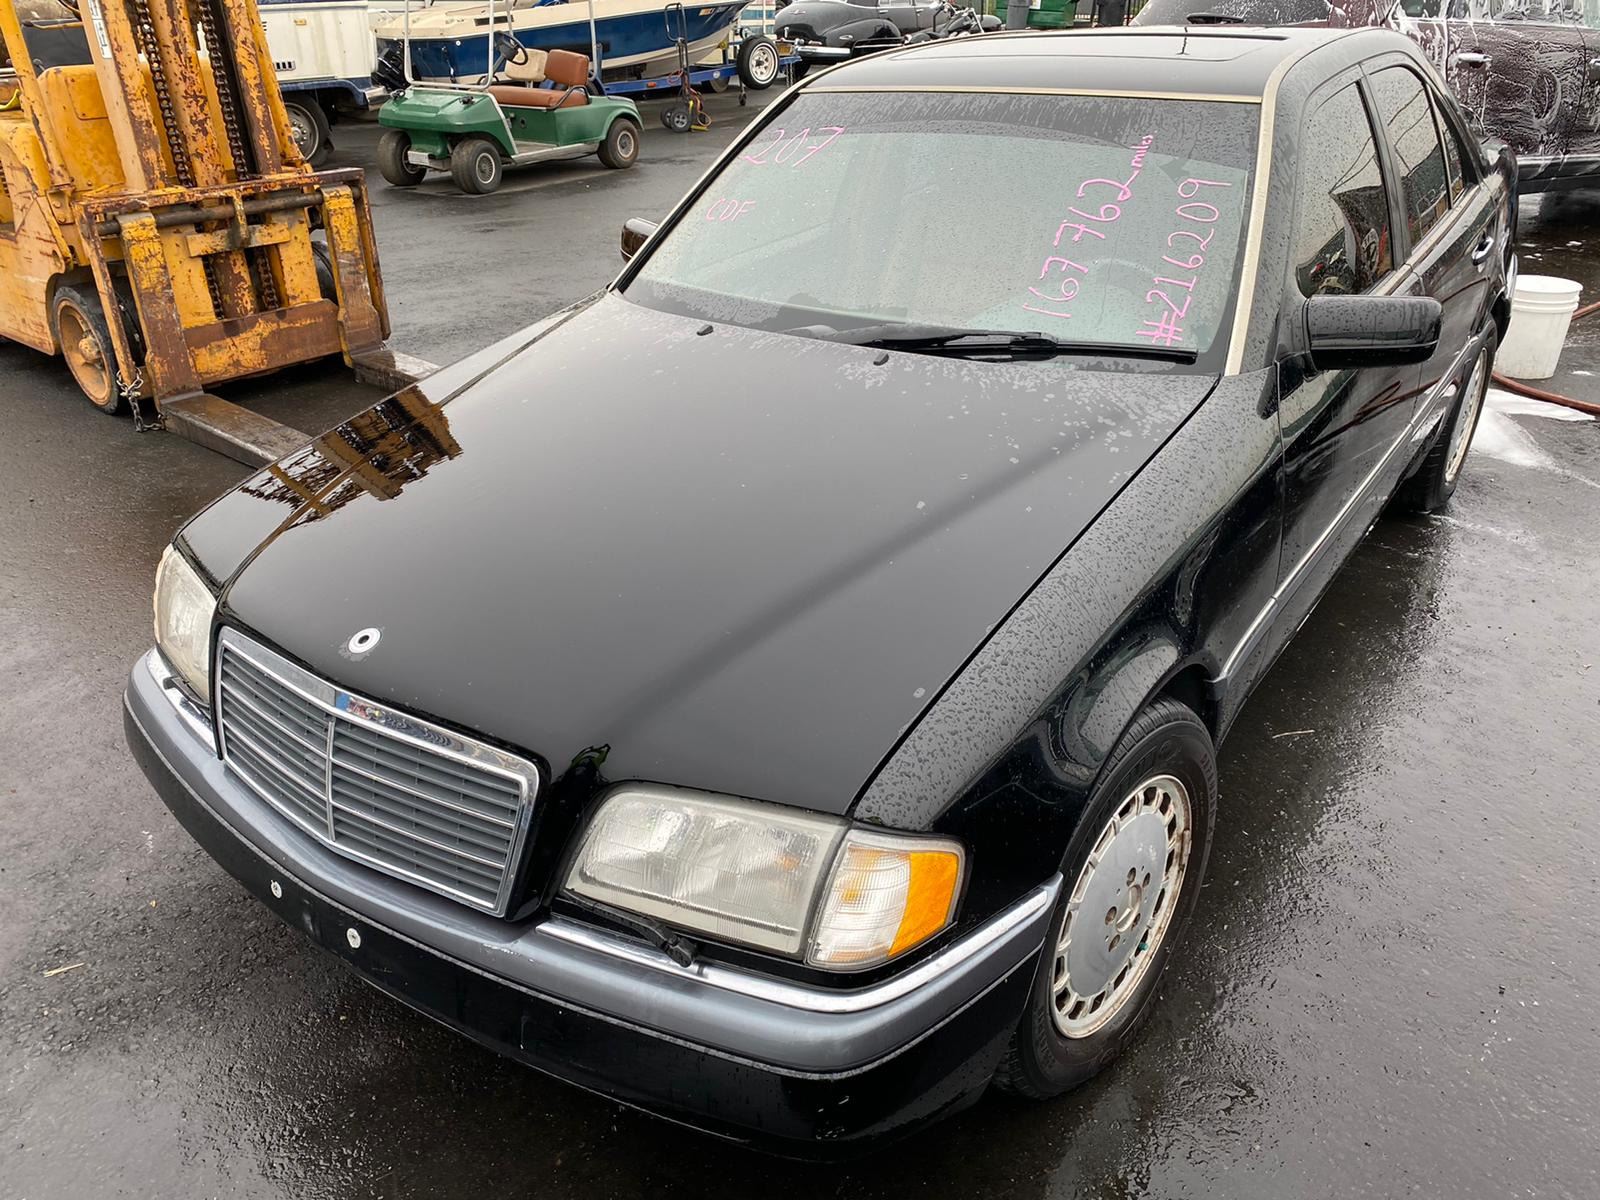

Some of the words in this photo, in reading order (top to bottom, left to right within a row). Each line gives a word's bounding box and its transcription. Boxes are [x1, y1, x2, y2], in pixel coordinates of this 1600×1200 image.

[744, 126, 846, 167] 207
[705, 198, 755, 222] CDF
[1022, 170, 1140, 318] 167762
[1136, 177, 1232, 347] #216209
